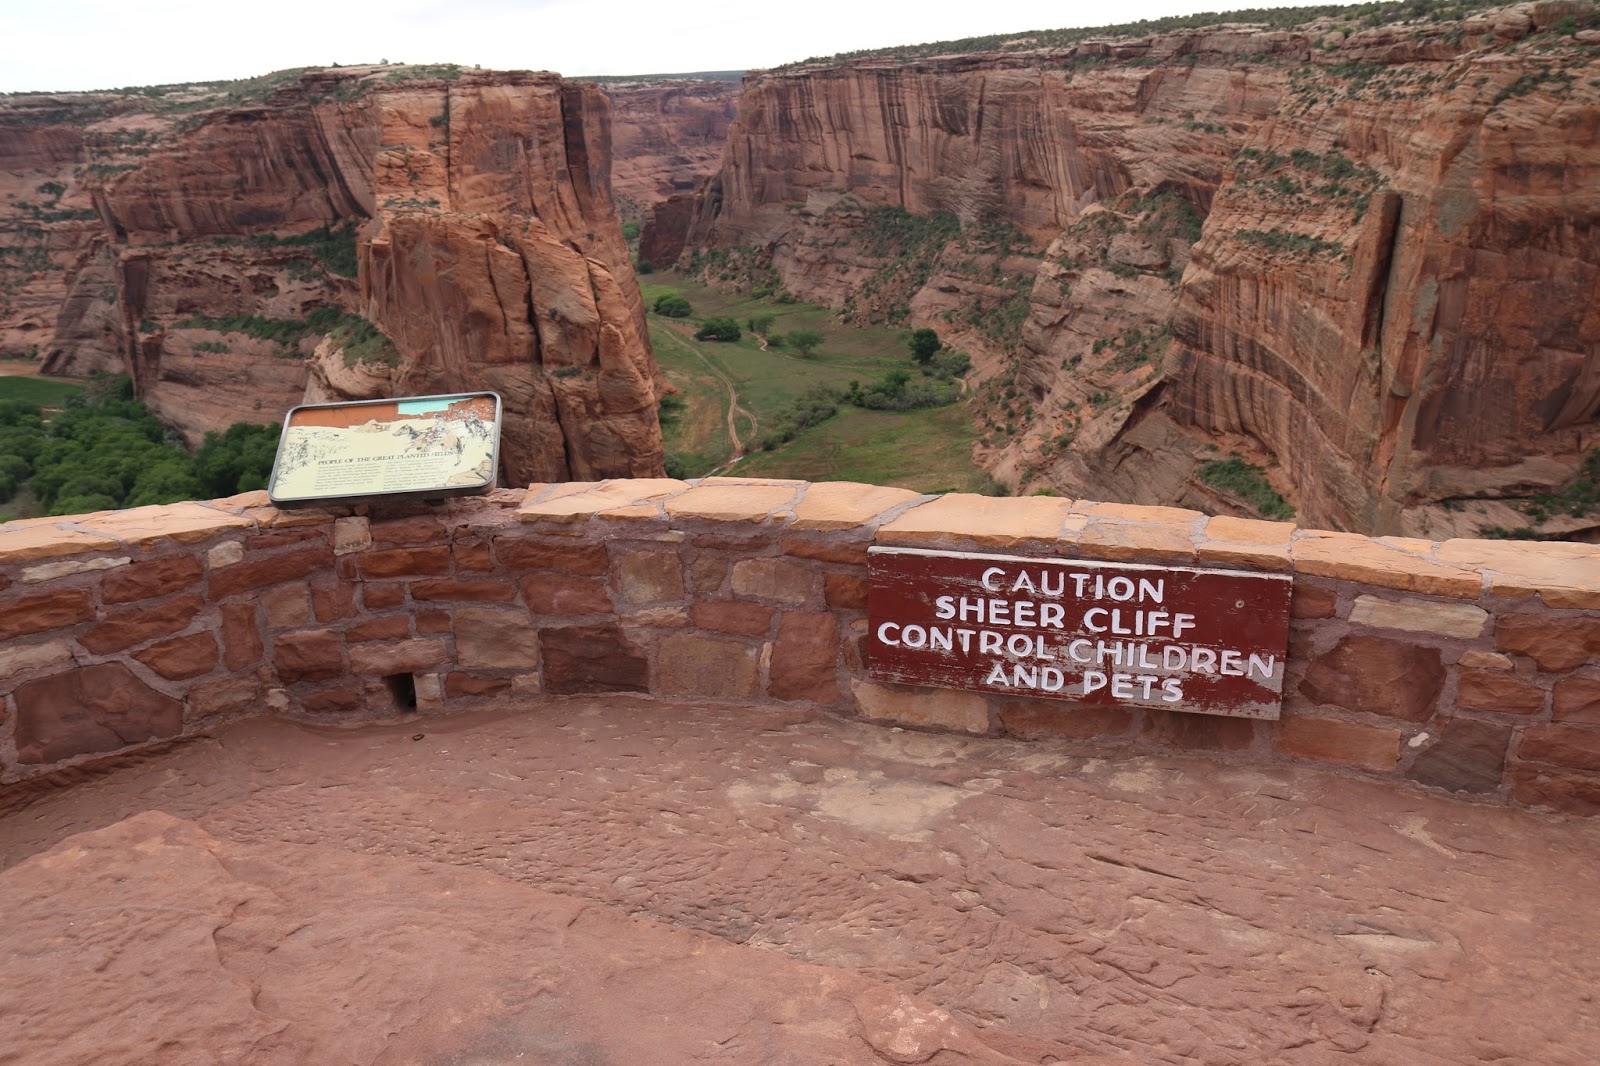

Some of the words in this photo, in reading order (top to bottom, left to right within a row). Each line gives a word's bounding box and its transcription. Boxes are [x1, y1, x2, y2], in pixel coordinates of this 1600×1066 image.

[397, 452, 430, 460] PLANTED
[981, 566, 1165, 604] CAUTION
[935, 595, 1066, 629] SHEER
[1083, 606, 1196, 639] CLIFF
[877, 621, 1056, 661] CONTROL
[1068, 637, 1275, 679] CHILDREN
[986, 663, 1065, 692] AND
[1083, 670, 1185, 703] PETS
